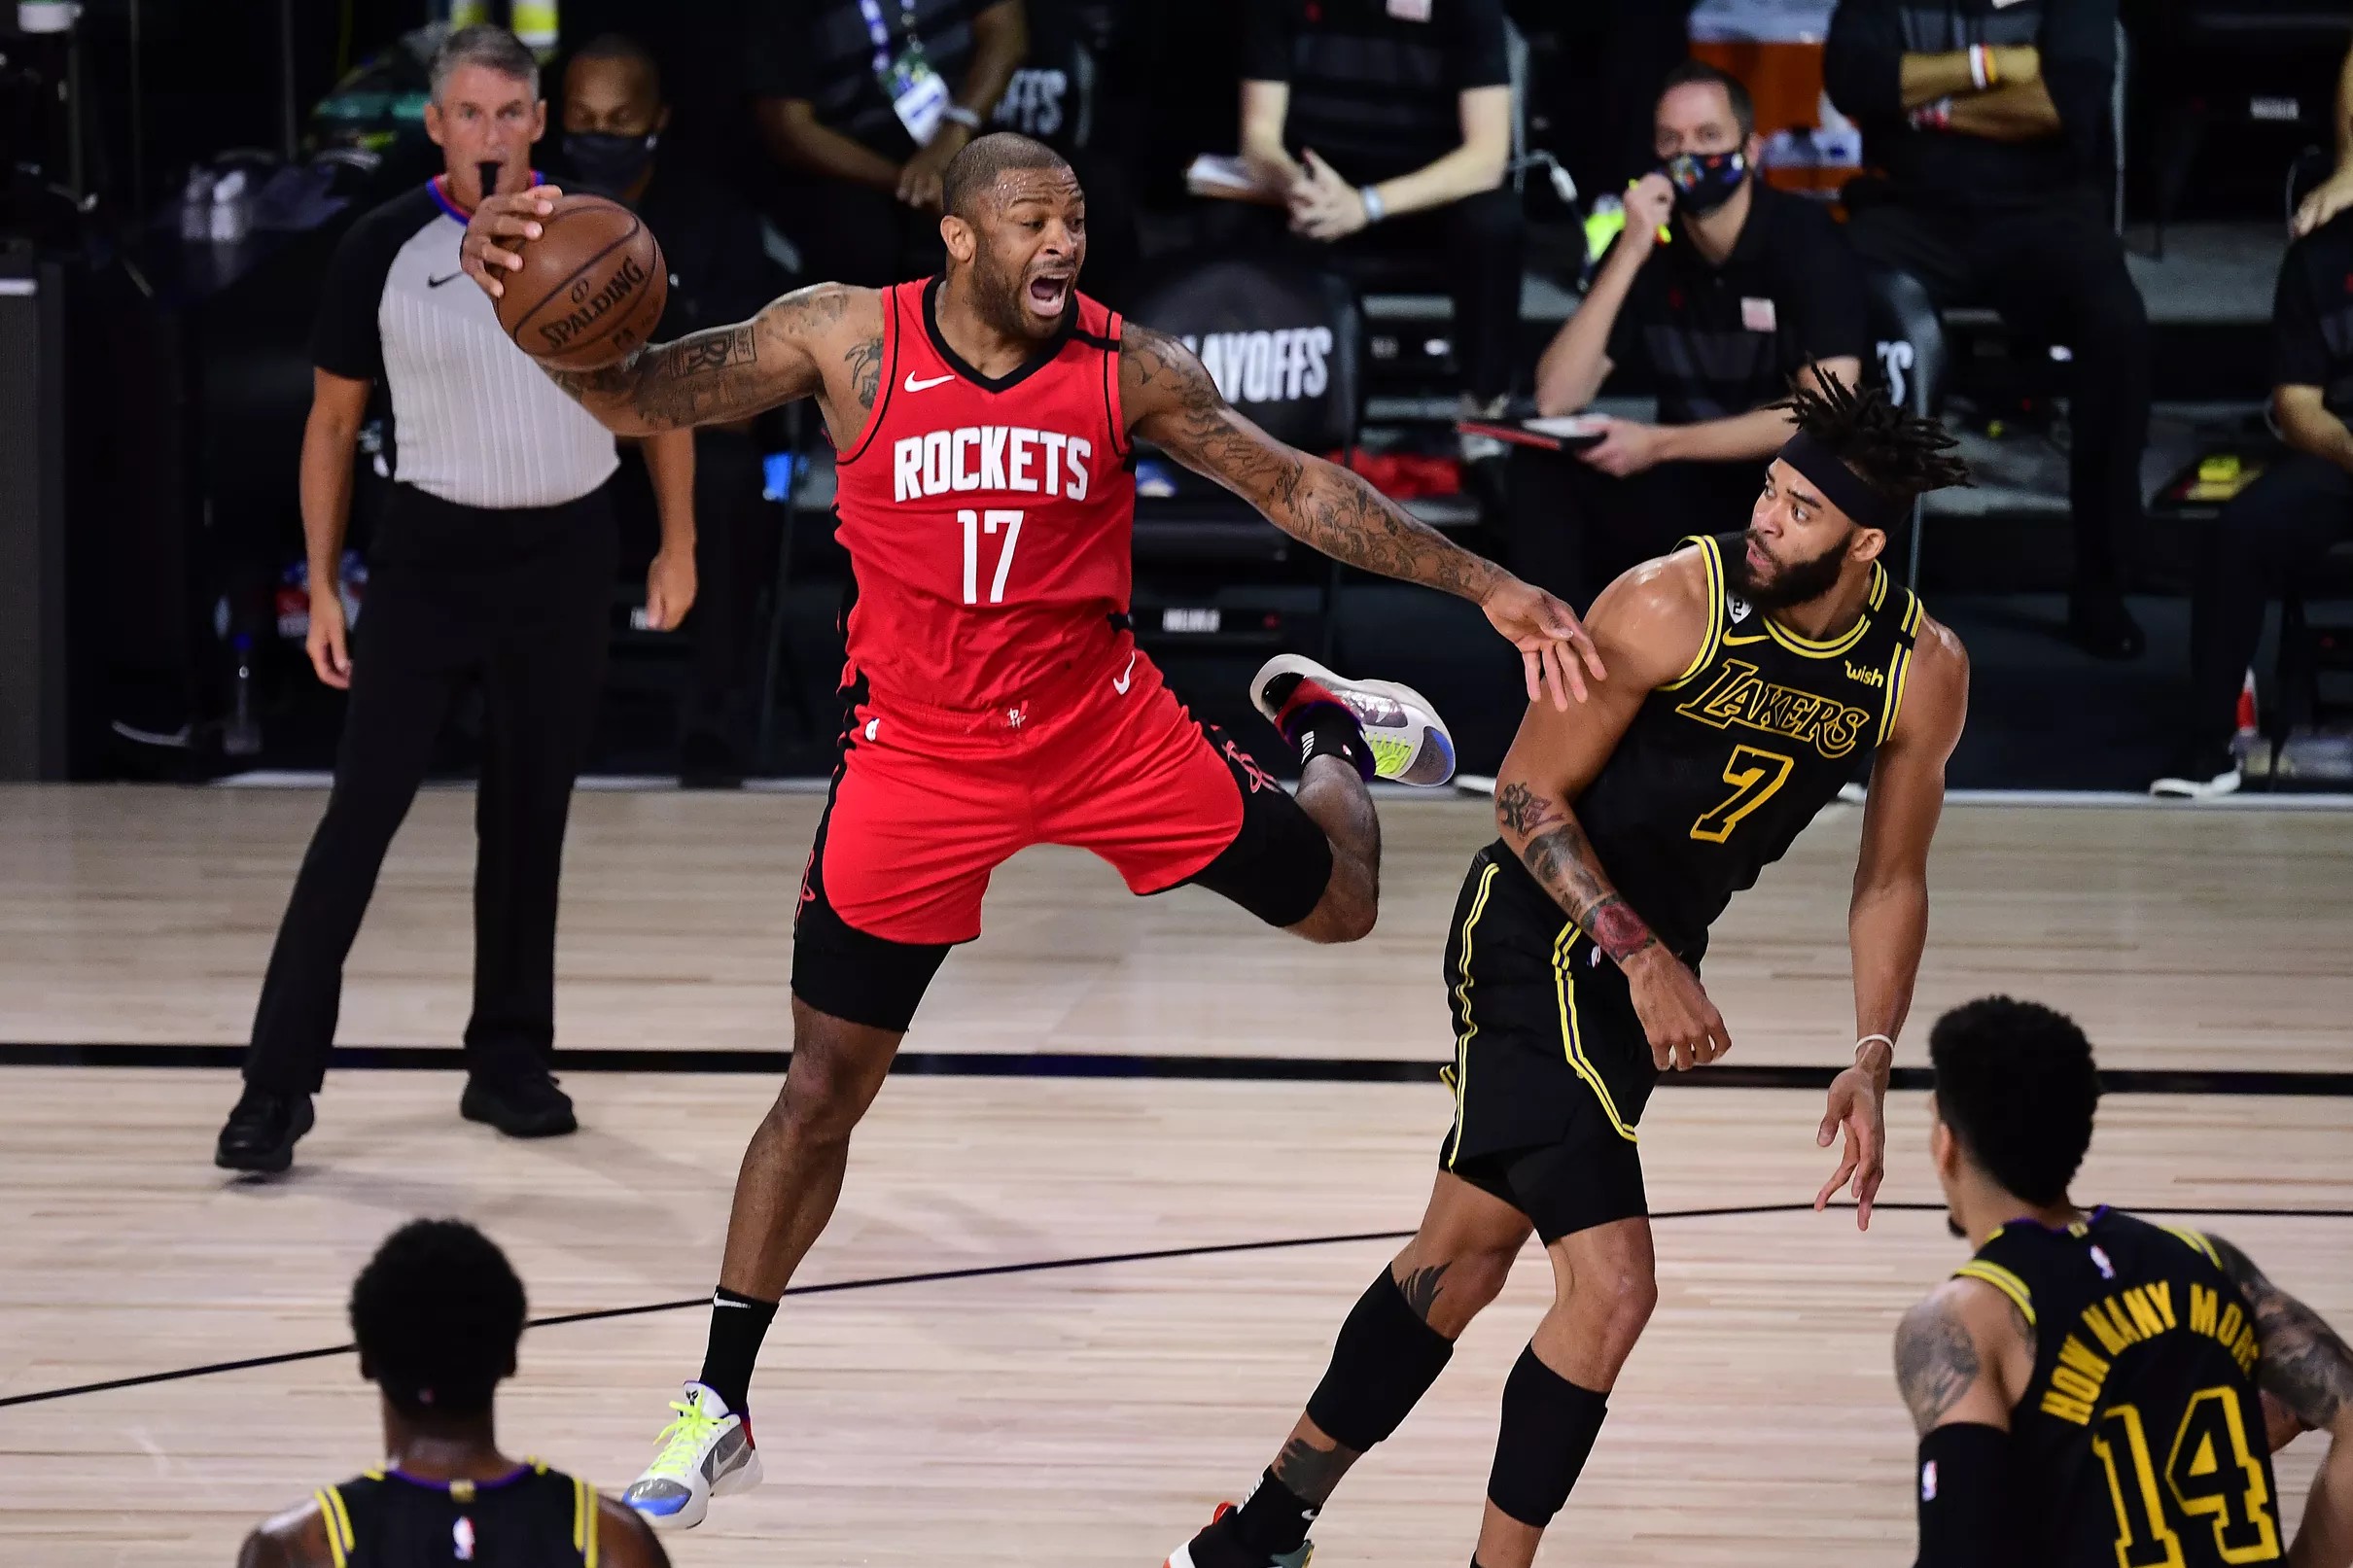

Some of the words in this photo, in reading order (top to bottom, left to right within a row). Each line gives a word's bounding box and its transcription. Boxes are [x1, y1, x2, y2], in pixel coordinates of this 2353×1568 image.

[539, 256, 644, 349] SPALDING
[1180, 326, 1333, 403] AYOFFS
[894, 426, 1092, 504] ROCKETS
[957, 509, 1025, 605] 17
[1733, 599, 1743, 616] 2
[1675, 658, 1871, 759] LAKERS
[1690, 744, 1794, 844] 7
[2039, 1333, 2111, 1426] HOW
[2081, 1278, 2178, 1357] MANY
[2091, 1385, 2281, 1568] 14
